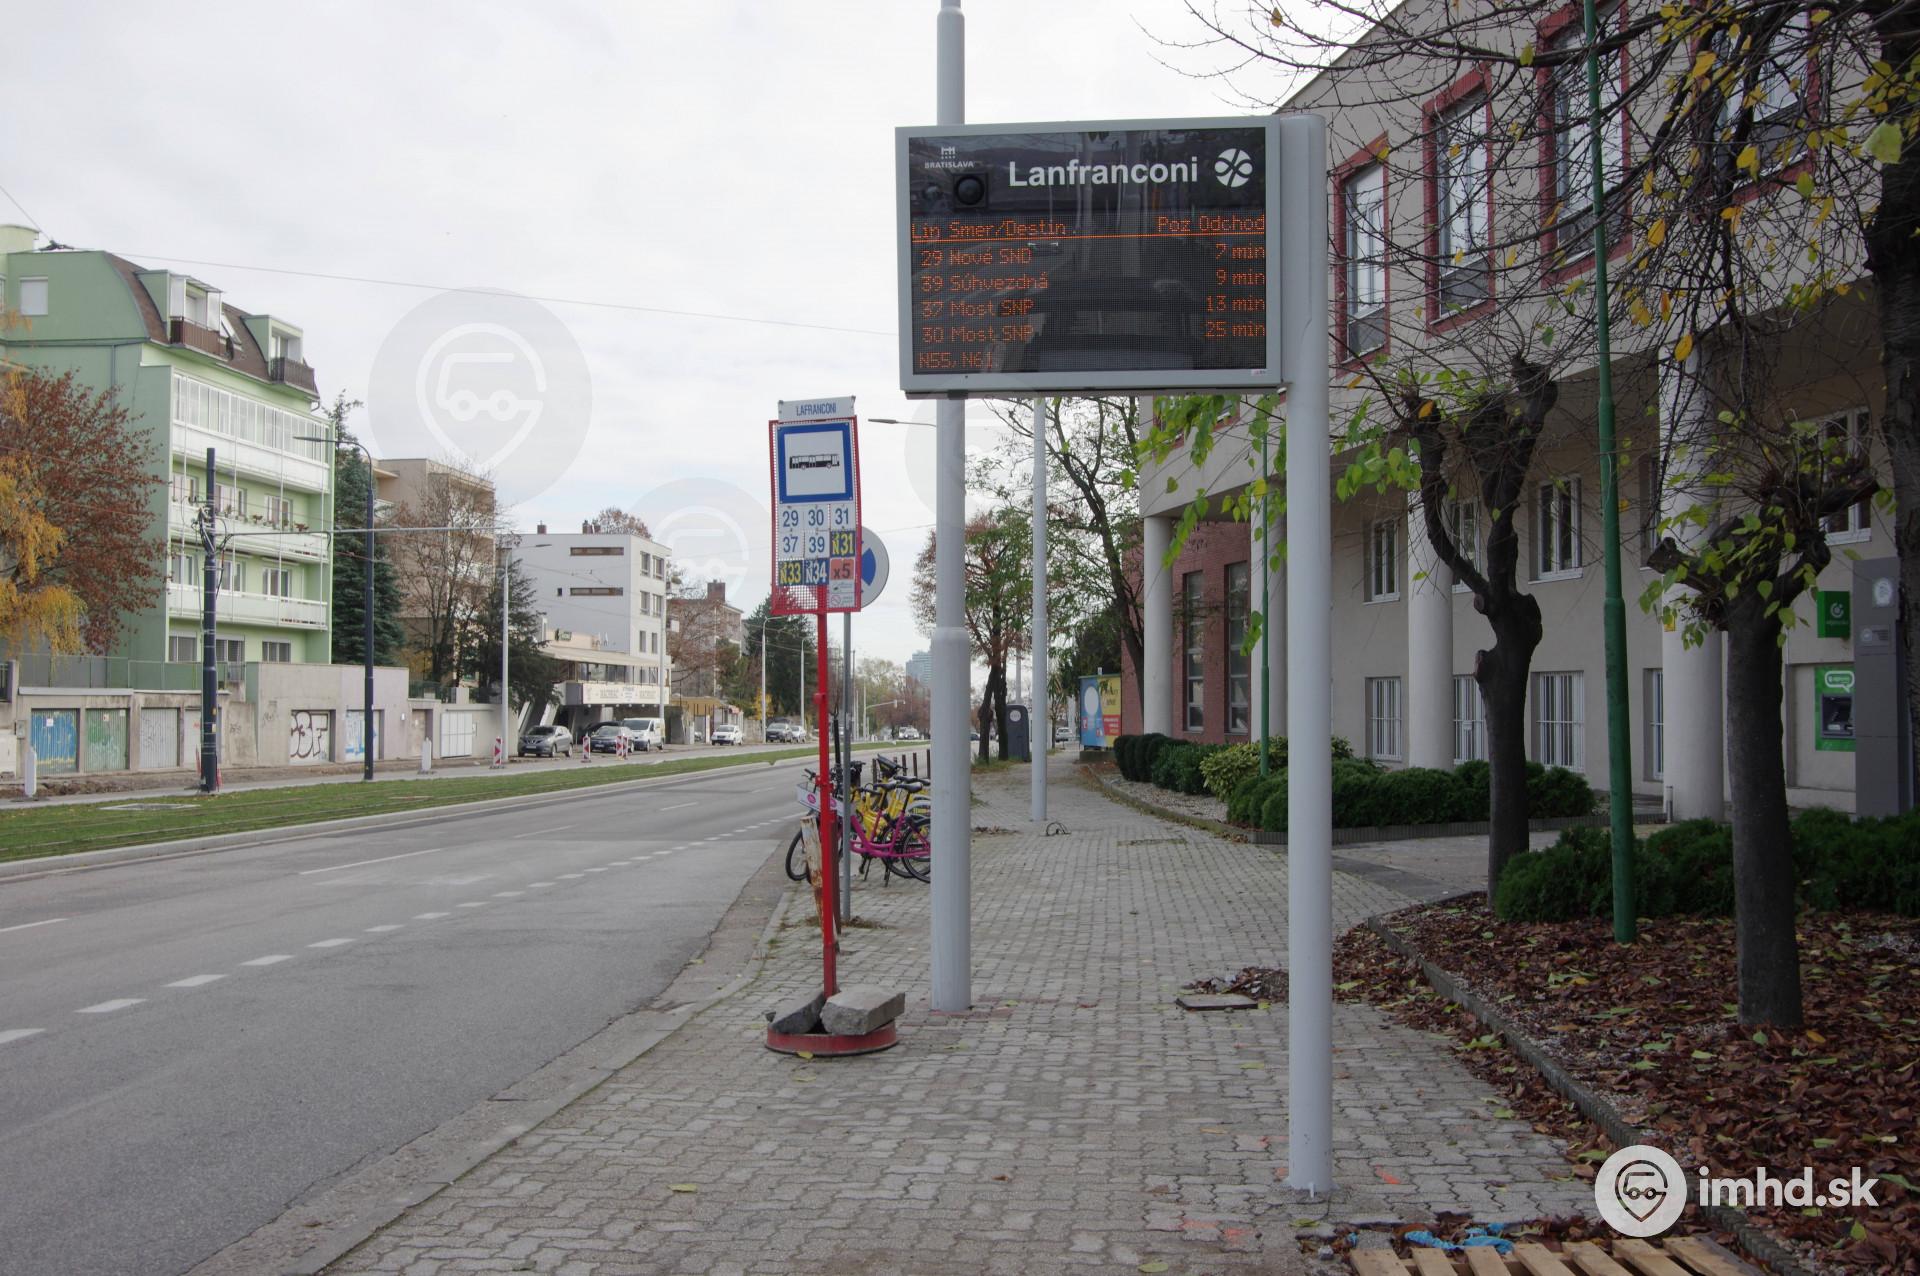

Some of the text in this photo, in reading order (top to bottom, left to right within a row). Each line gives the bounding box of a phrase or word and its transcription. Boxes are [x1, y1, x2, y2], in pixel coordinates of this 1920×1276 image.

[924, 160, 975, 169] BRATISLAVA
[1009, 156, 1198, 187] Lanfranconi
[911, 214, 1265, 239] Lin Smer/Destin Poz Odchod
[921, 243, 1265, 266] 29 Nové SND 7 min
[921, 268, 1265, 292] 39 Súhvezdná 9 min
[921, 294, 1265, 319] 37 Most SNP 13 min
[922, 320, 1265, 343] 30 Most SNP 25 min
[796, 402, 837, 417] LAFRANCONI
[782, 508, 849, 527] 29 30 31
[783, 533, 854, 555] 37 39 N31
[780, 562, 851, 584] N33 N34 x5
